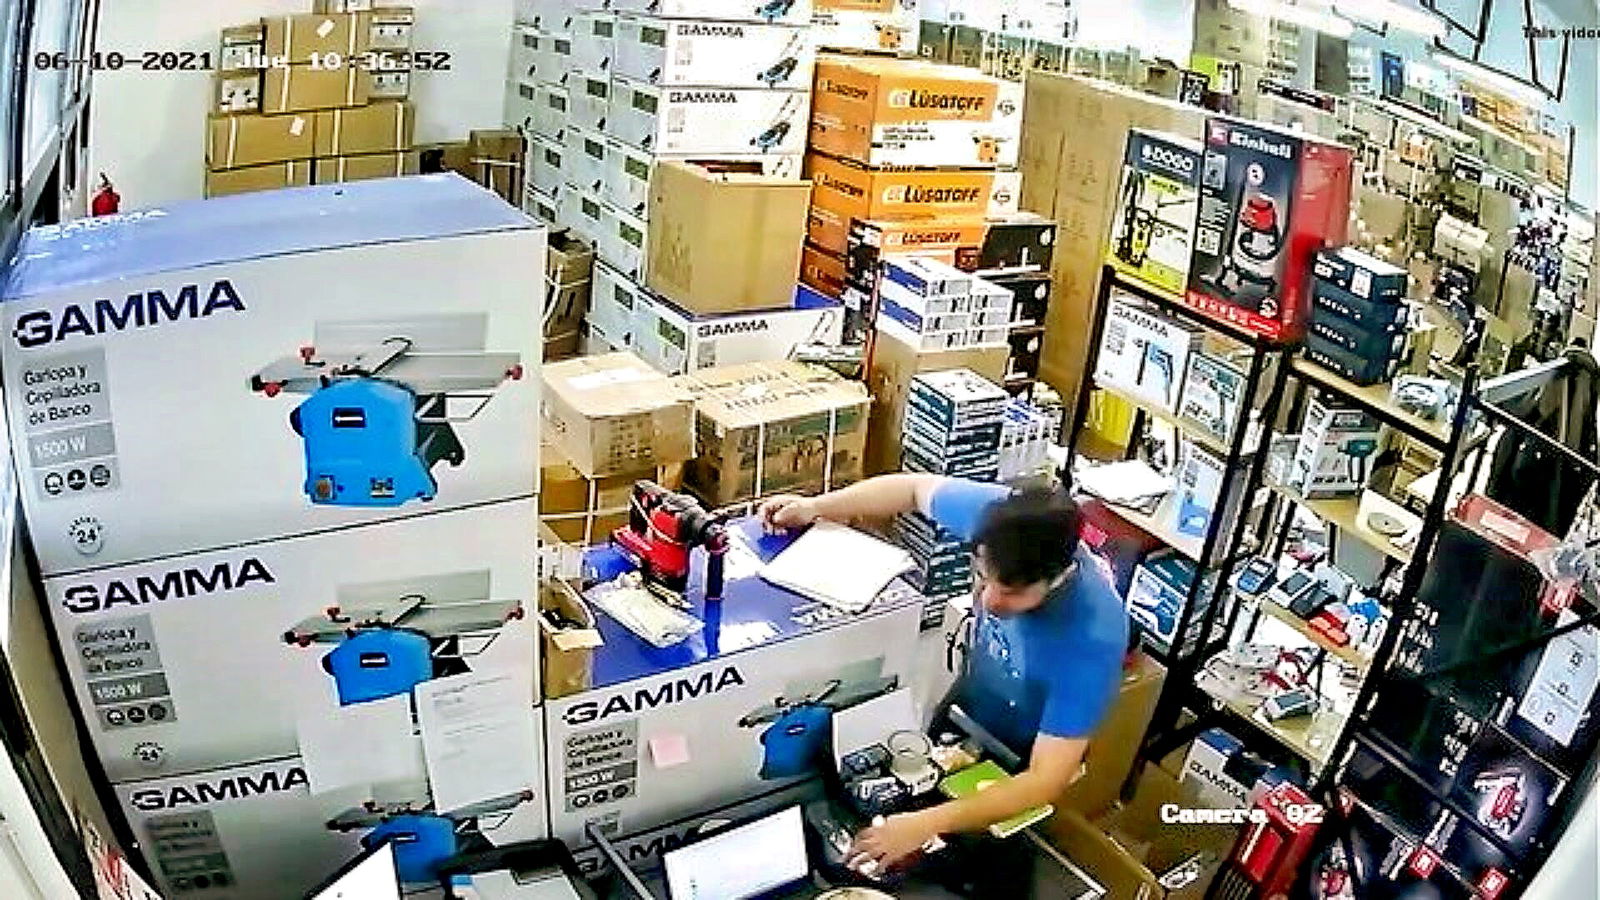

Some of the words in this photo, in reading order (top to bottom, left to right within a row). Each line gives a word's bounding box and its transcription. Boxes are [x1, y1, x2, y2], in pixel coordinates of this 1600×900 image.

[13, 280, 245, 348] GAMMA
[697, 319, 769, 338] GAMMA
[62, 557, 275, 614] GAMMA
[562, 666, 745, 725] GAMMA
[131, 766, 309, 811] GAMMA
